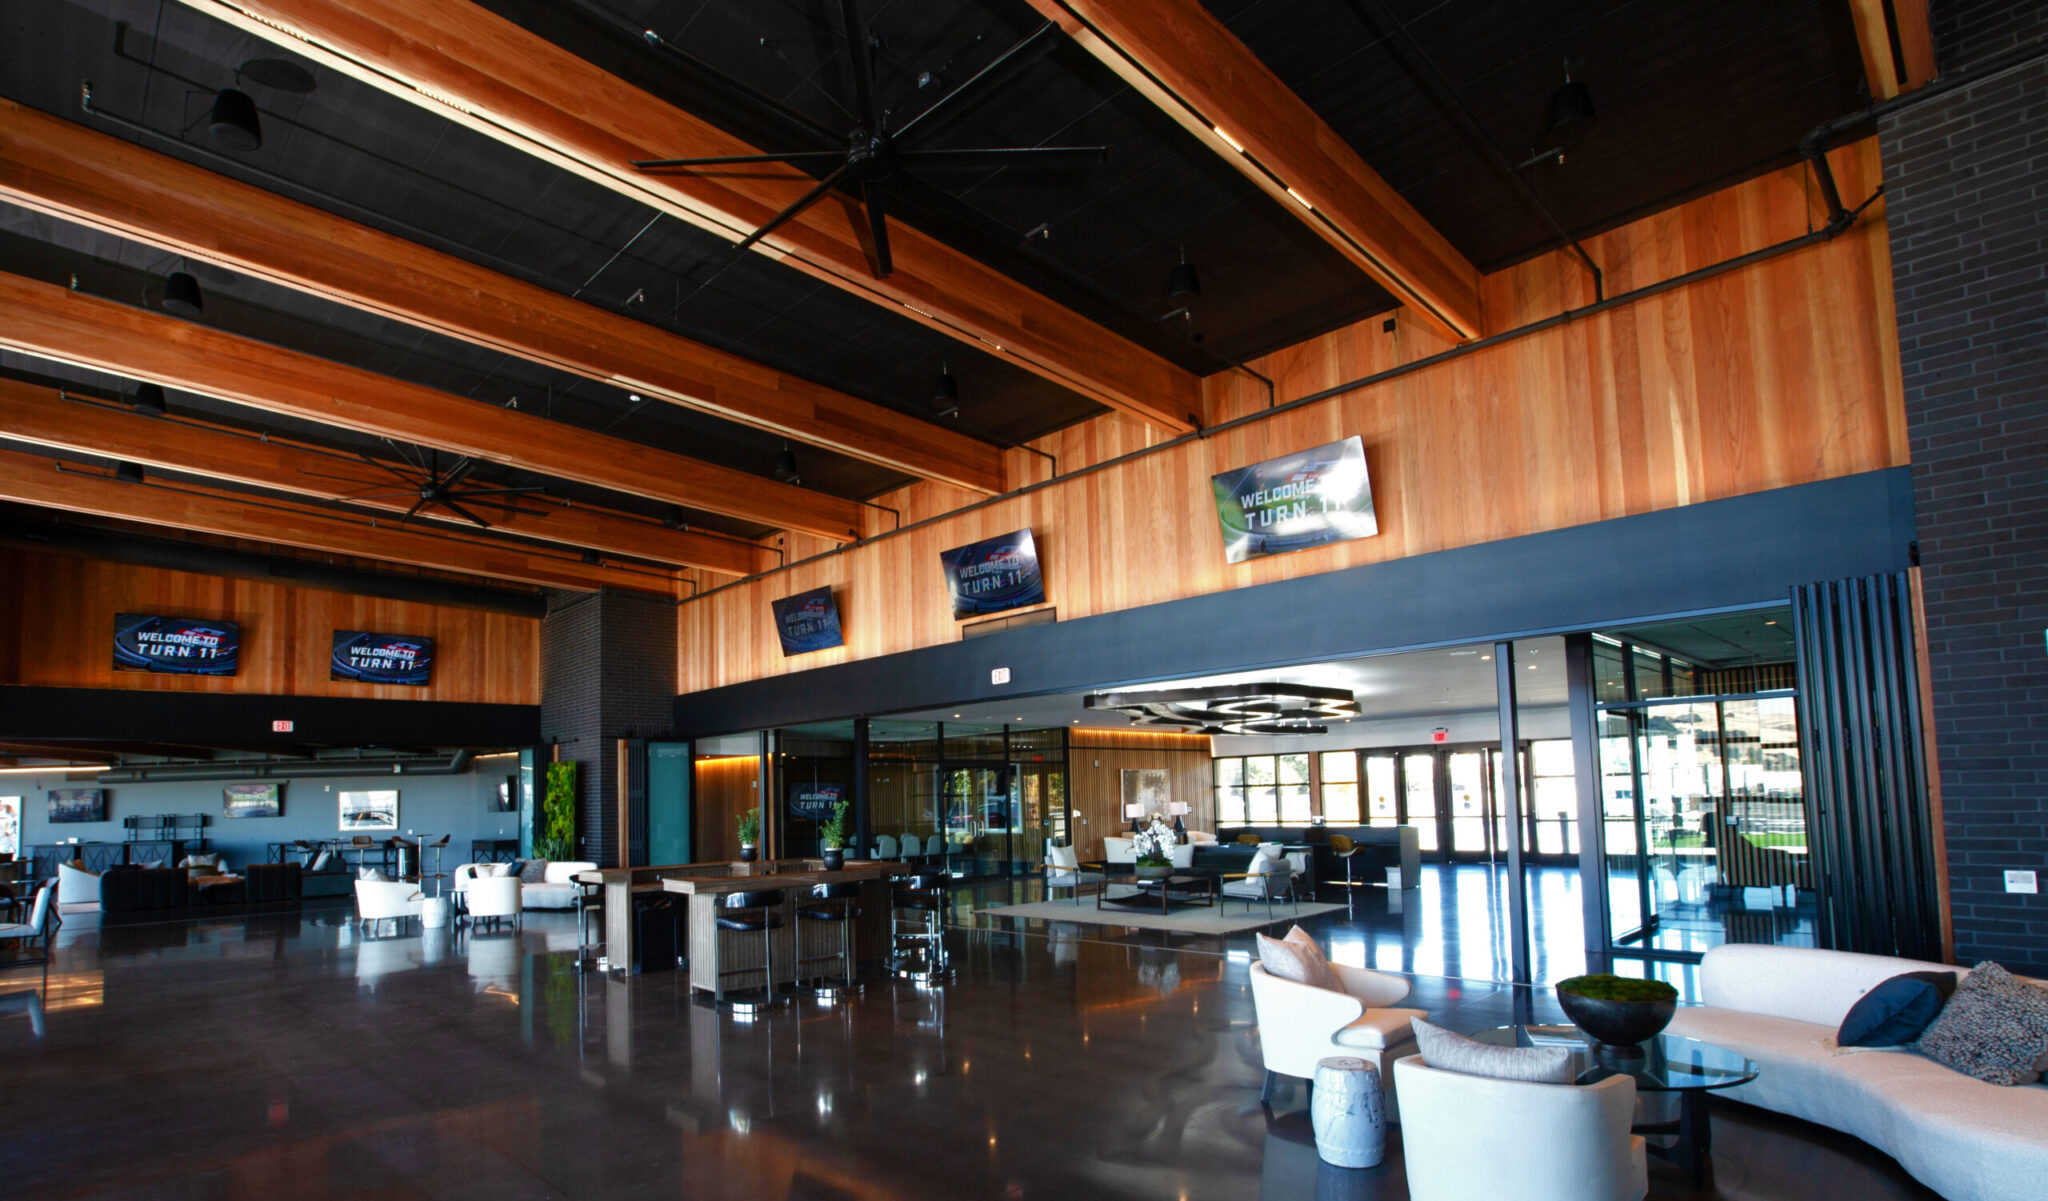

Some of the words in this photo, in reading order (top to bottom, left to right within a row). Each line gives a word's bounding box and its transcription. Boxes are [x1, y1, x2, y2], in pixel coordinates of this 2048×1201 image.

[1241, 479, 1315, 509] WELCOME
[1245, 501, 1306, 530] TURN
[960, 558, 1005, 579] WELCOME
[1007, 554, 1019, 568] TO
[963, 574, 1001, 595] TURN
[1008, 569, 1023, 586] 11
[785, 608, 816, 624] WELCOME
[788, 621, 814, 637] TURN
[137, 631, 201, 645] WELCOME
[203, 635, 219, 646] TO
[138, 643, 191, 657] TURN
[200, 647, 217, 659] 11
[351, 646, 401, 658] WELCOME
[402, 650, 416, 659] TO
[351, 656, 393, 669] TURN
[400, 660, 414, 670] 11
[800, 801, 825, 809] TURN
